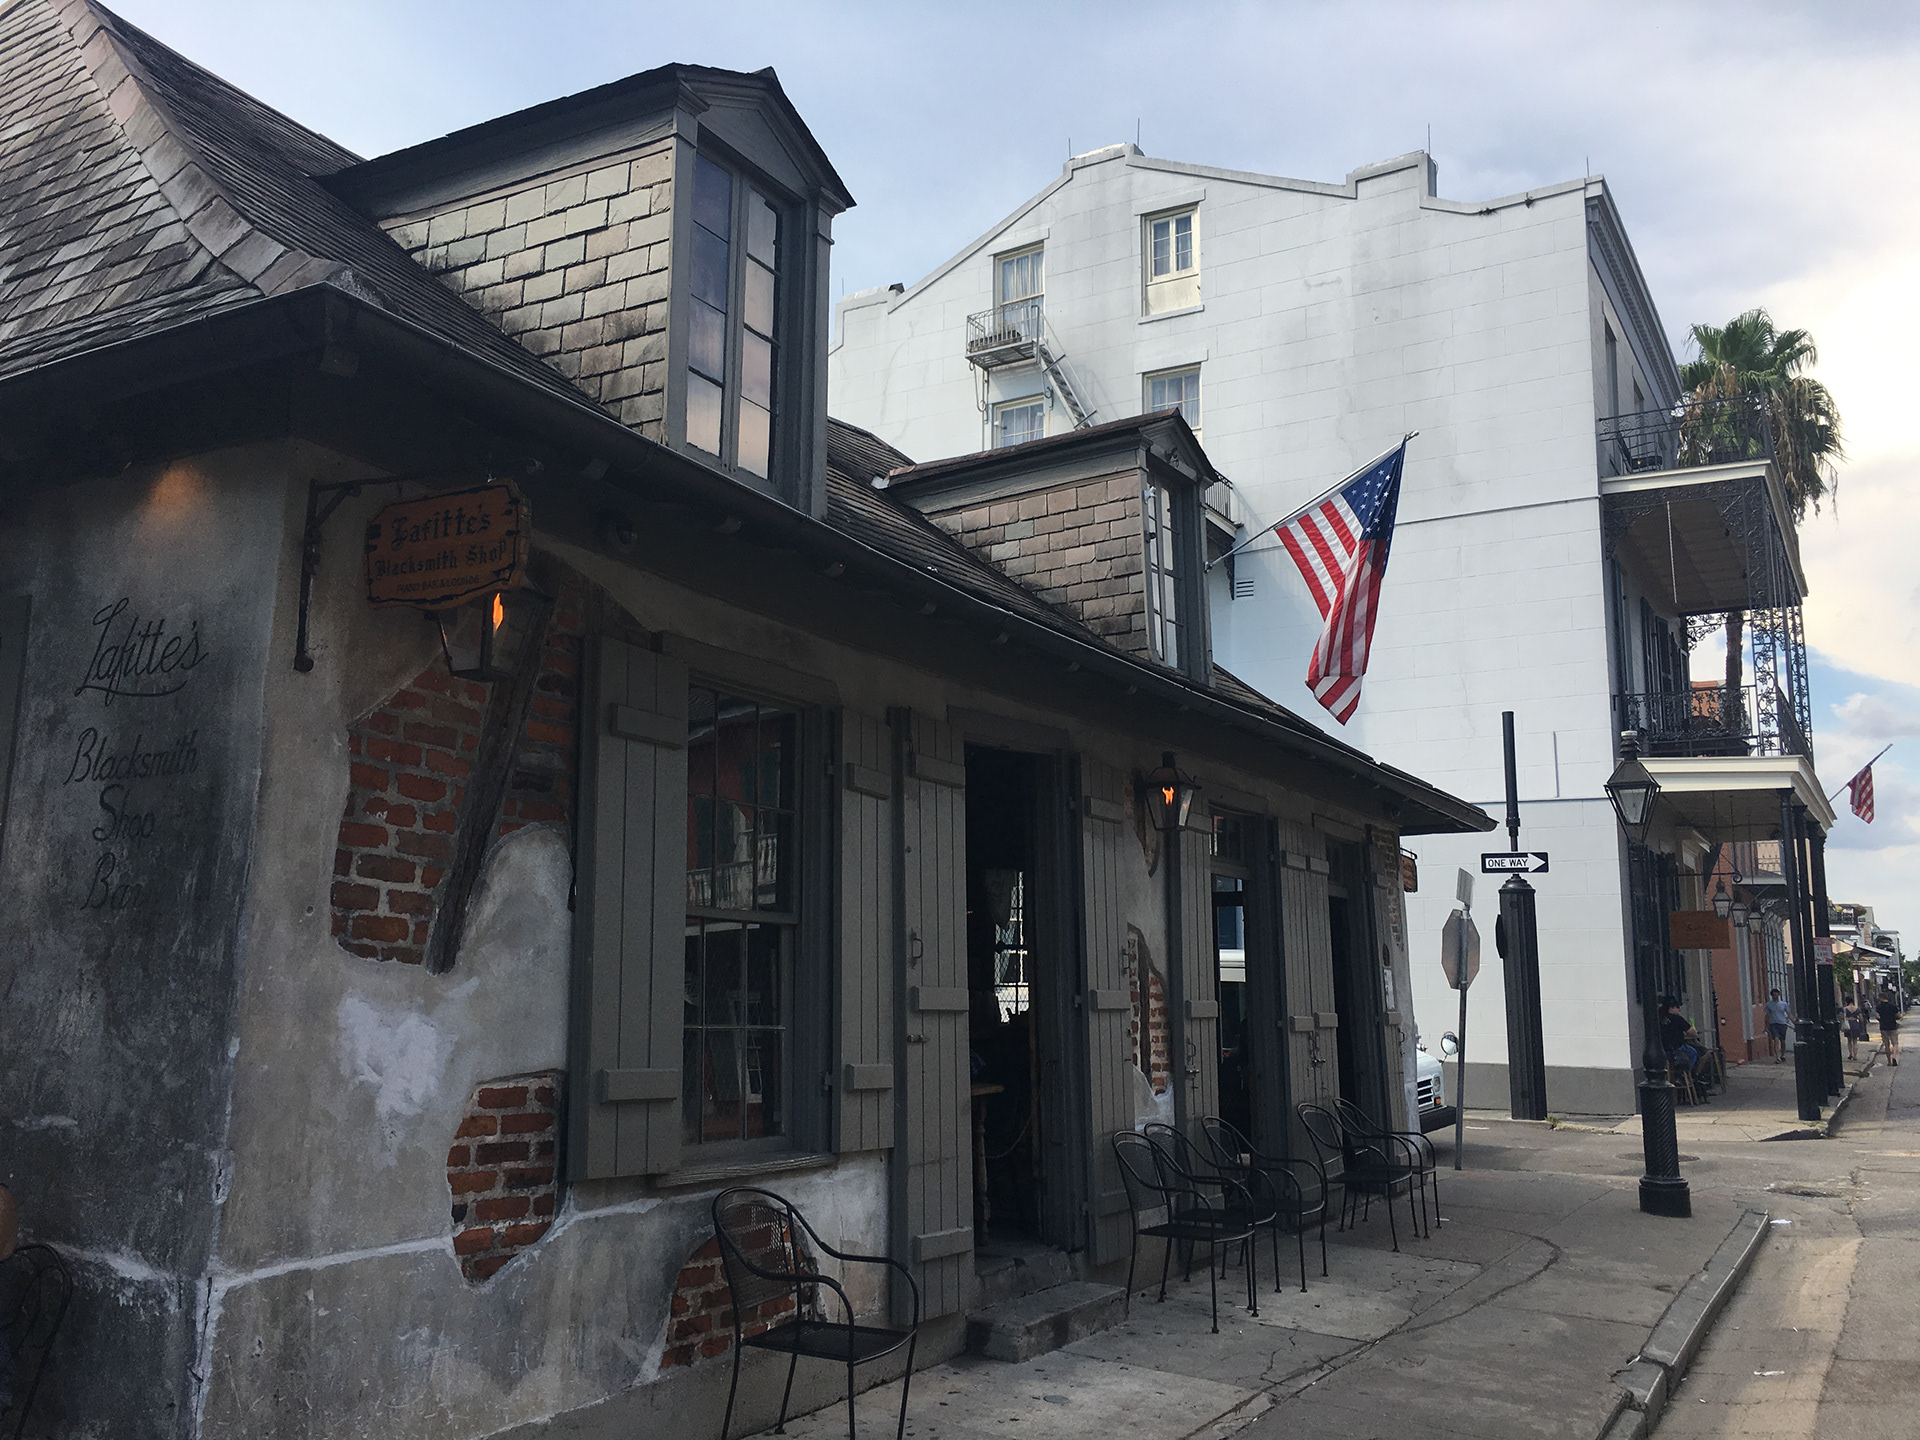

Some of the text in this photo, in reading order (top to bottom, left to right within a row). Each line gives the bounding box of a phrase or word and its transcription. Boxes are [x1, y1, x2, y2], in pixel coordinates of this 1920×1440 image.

[391, 504, 490, 552] Lafitte's
[375, 550, 458, 577] Blacksmith
[74, 597, 209, 707] Lafitte's
[63, 727, 199, 785] Blacksmith
[80, 852, 146, 911] Bar
[1487, 858, 1528, 868] ONE WAY
